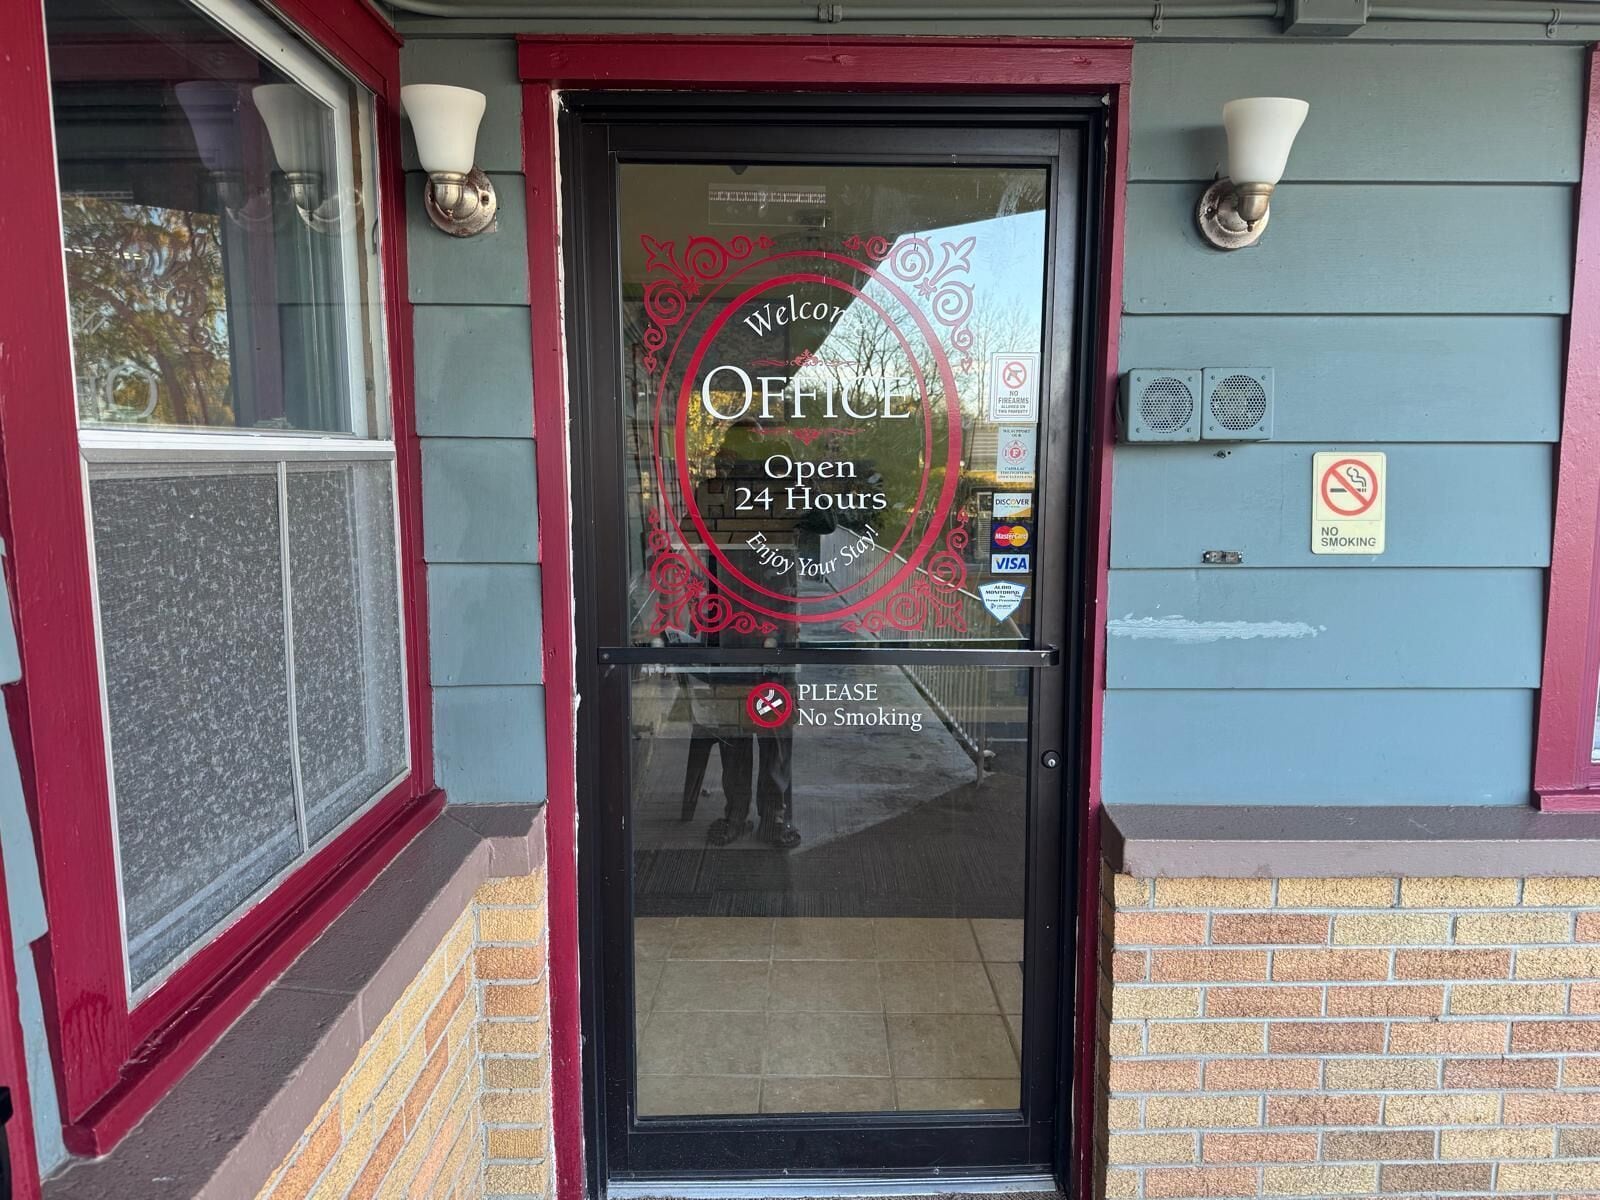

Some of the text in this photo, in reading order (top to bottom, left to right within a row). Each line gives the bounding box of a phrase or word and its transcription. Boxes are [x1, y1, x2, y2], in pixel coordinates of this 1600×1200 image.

[701, 365, 911, 420] OFFICE
[764, 454, 857, 487] Open
[735, 487, 887, 511] 24 Hours
[995, 498, 1029, 506] DISCOVER
[1321, 526, 1339, 537] NO
[1321, 537, 1377, 547] SMOKING
[745, 523, 879, 577] Enjoy Your Stay!
[995, 557, 1028, 570] VISA
[797, 683, 878, 701] PLEASE
[797, 706, 923, 732] No Smoking
